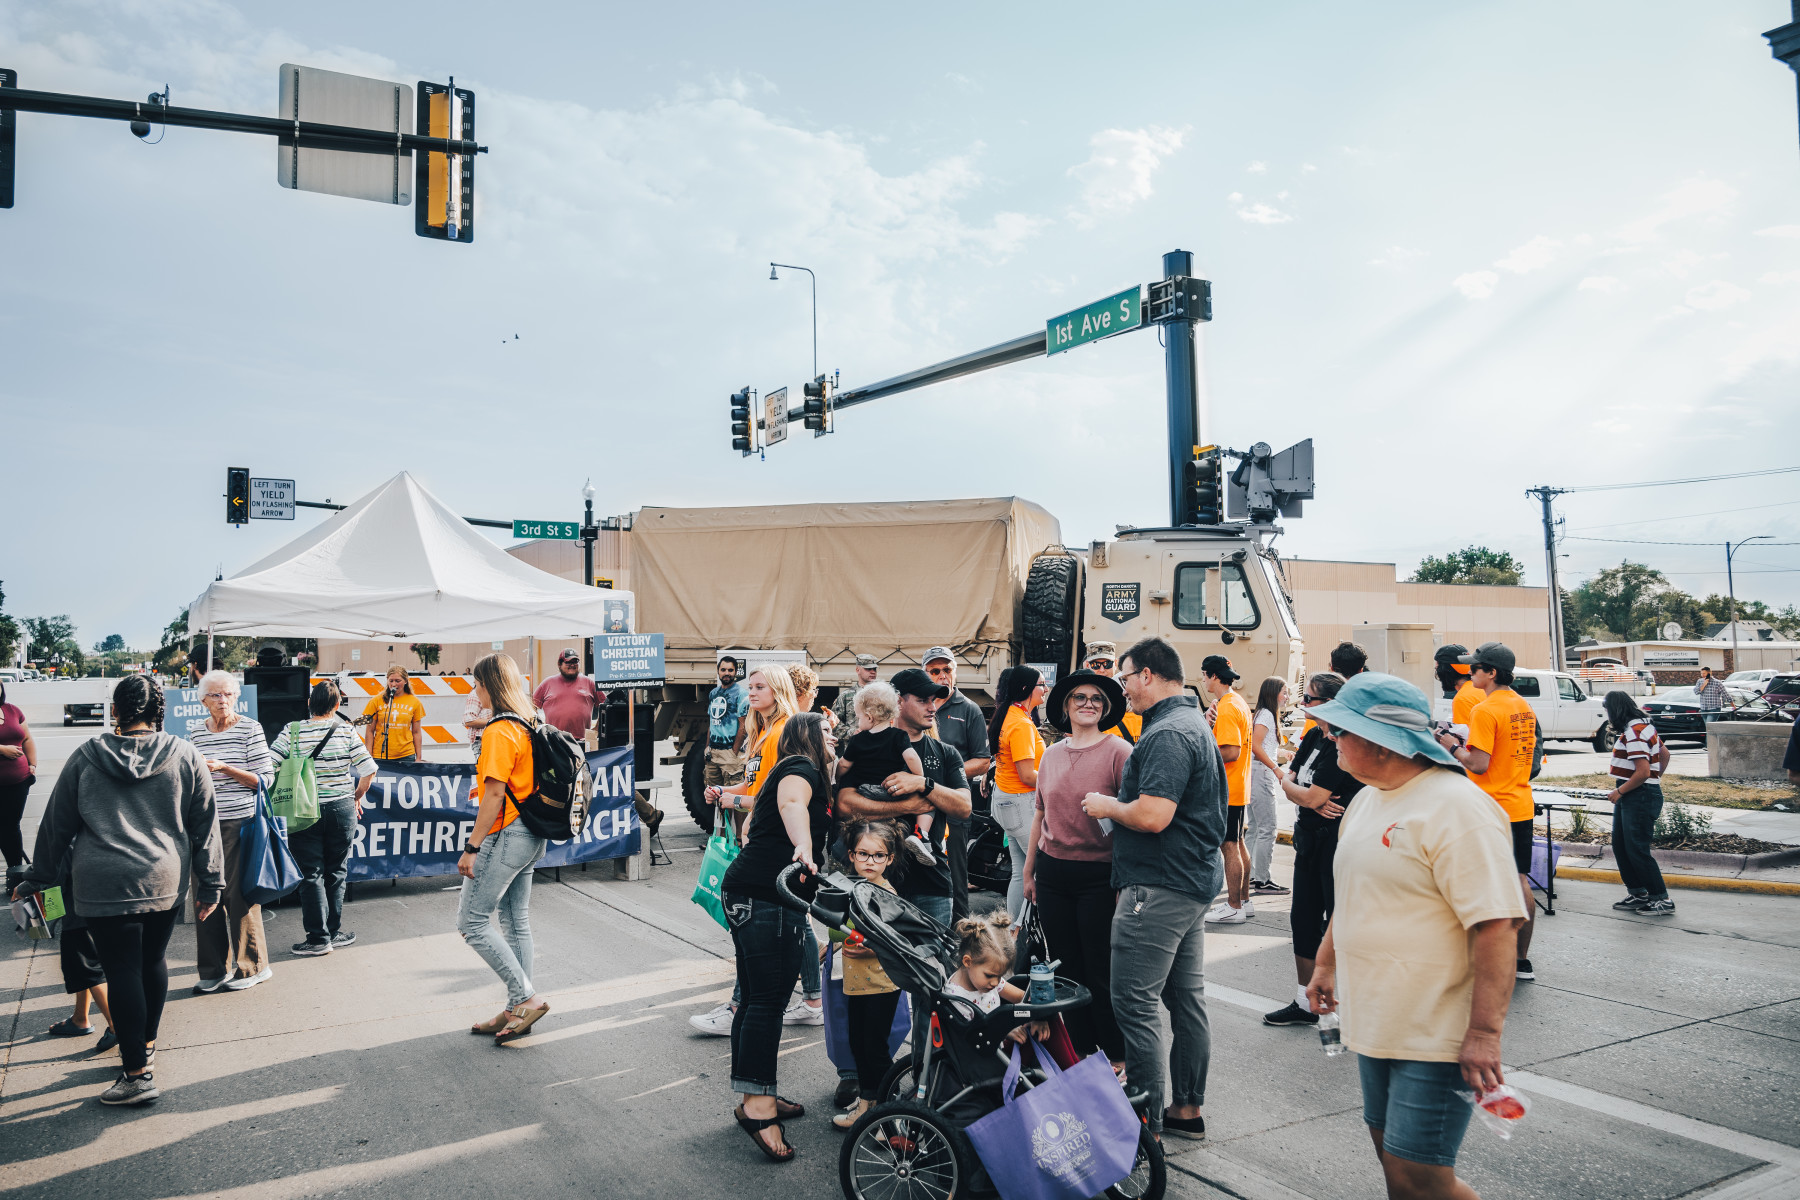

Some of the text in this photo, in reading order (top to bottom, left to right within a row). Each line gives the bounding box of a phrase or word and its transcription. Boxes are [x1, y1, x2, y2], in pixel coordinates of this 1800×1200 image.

[1055, 298, 1130, 345] 1st Ave S
[260, 490, 285, 499] YIELD
[262, 501, 294, 509] FLASHING
[261, 509, 284, 517] ARROW
[521, 523, 573, 537] 3rd St S
[1106, 590, 1136, 599] ARMY
[1105, 603, 1137, 611] GUARD
[607, 635, 651, 647] VICTORY
[601, 647, 658, 659] CHRISTIAN
[610, 659, 651, 671] SCHOOL
[597, 680, 664, 689] VictoryChristianSchool.org
[173, 701, 248, 717] CHRIAN
[351, 773, 462, 810] CTORY
[347, 820, 475, 858] RETHRE
[1037, 1132, 1091, 1169] INSPIRED
